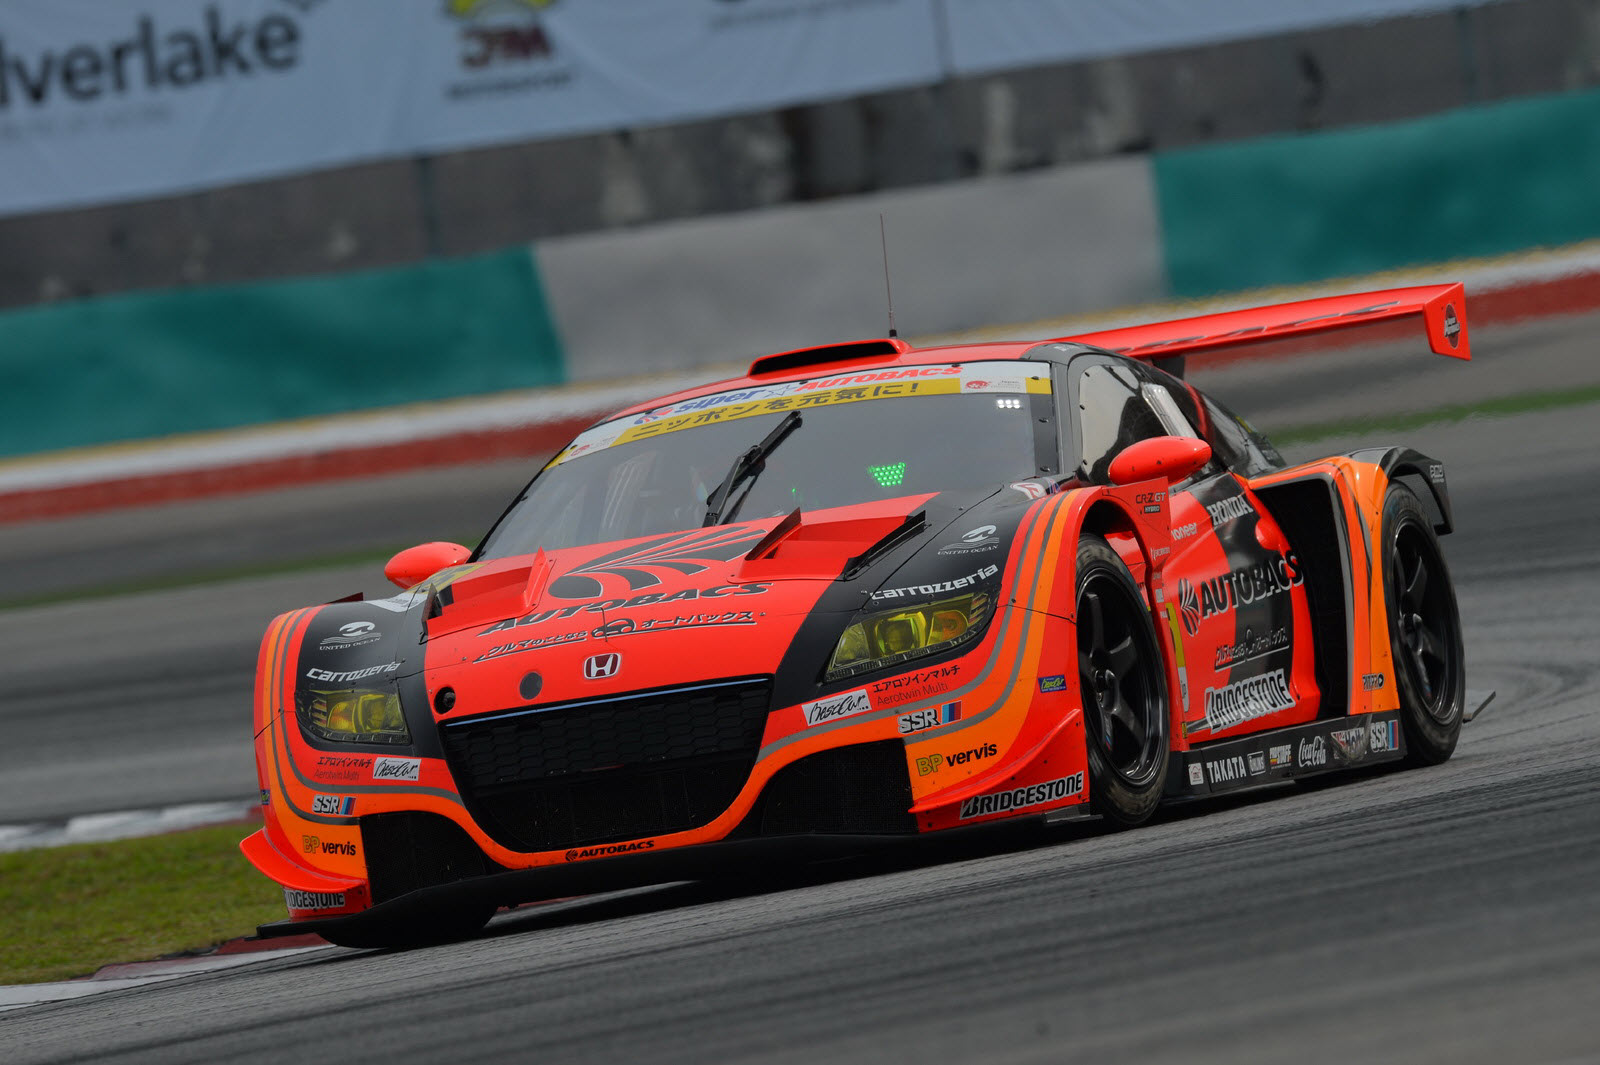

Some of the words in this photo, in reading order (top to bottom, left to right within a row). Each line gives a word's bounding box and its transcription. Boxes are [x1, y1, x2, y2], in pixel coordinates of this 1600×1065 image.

[794, 366, 963, 393] AUTOBACS
[1206, 494, 1254, 527] HONDA
[971, 544, 999, 553] OCEAN
[869, 564, 999, 601] carrozzeria
[1202, 554, 1304, 619] AUTOBACS
[476, 582, 774, 638] AUTOBACS
[353, 637, 381, 647] OCEAN
[306, 661, 400, 682] carrozzeria
[872, 664, 961, 693] エアロツインマルチ
[877, 689, 921, 706] Aerotwin
[922, 682, 949, 696] Multi
[1205, 669, 1296, 734] BRIDGESTONE
[898, 708, 938, 734] SSR
[1370, 721, 1388, 753] SSR
[916, 753, 944, 777] BP
[946, 742, 998, 768] vervis
[1206, 755, 1247, 784] TAKATA
[312, 794, 341, 815] SSR
[961, 772, 1084, 820] BRIDGESTONE
[302, 835, 320, 854] BP
[321, 841, 357, 857] vervis
[579, 840, 655, 858] AUTOBACS
